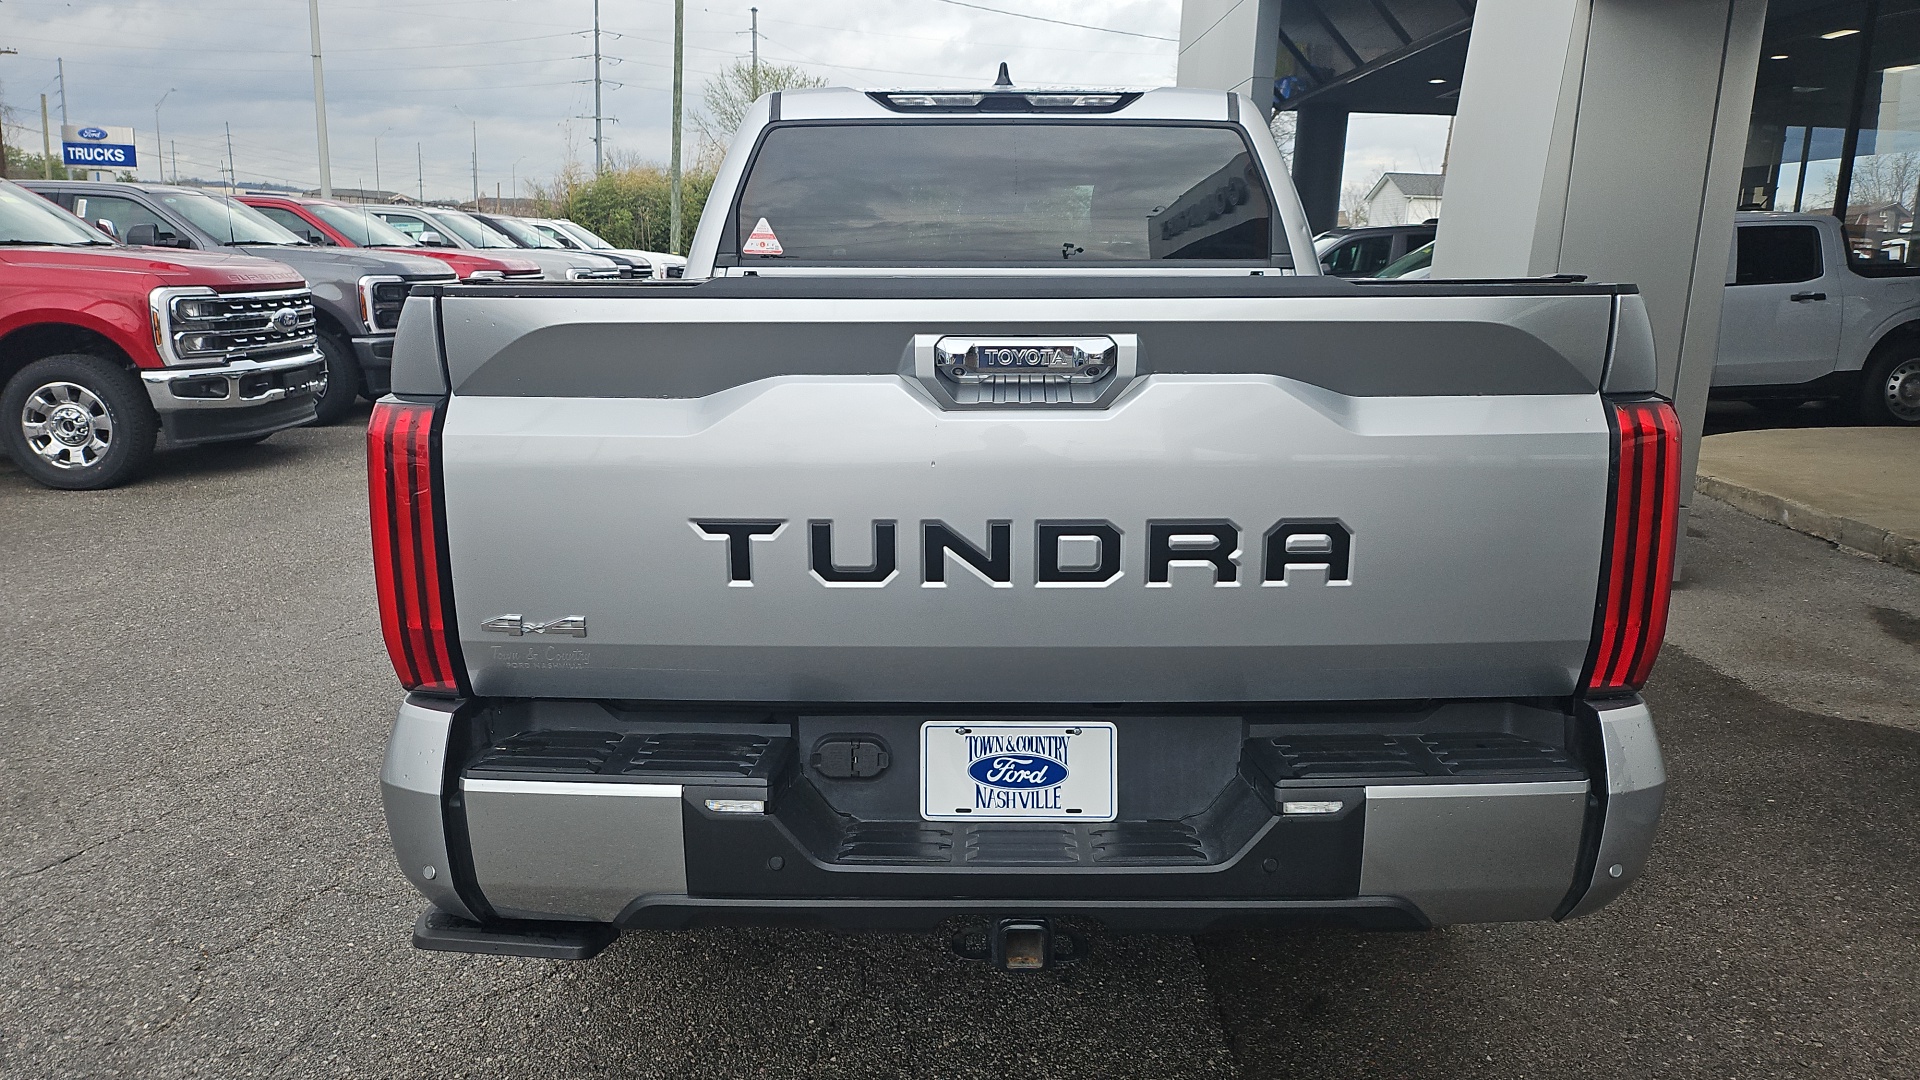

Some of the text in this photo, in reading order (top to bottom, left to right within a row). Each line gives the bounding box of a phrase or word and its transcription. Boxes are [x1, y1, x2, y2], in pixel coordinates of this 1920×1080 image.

[67, 147, 125, 162] TRUCKS
[984, 348, 1067, 366] TOYOTA
[687, 516, 1356, 589] TUNDRA
[480, 613, 587, 638] 4x4
[490, 645, 591, 664] Town & Country
[965, 735, 1071, 765] TOWN & COUNTRY
[986, 756, 1049, 784] Ford
[974, 784, 1062, 809] NASHVILLE
